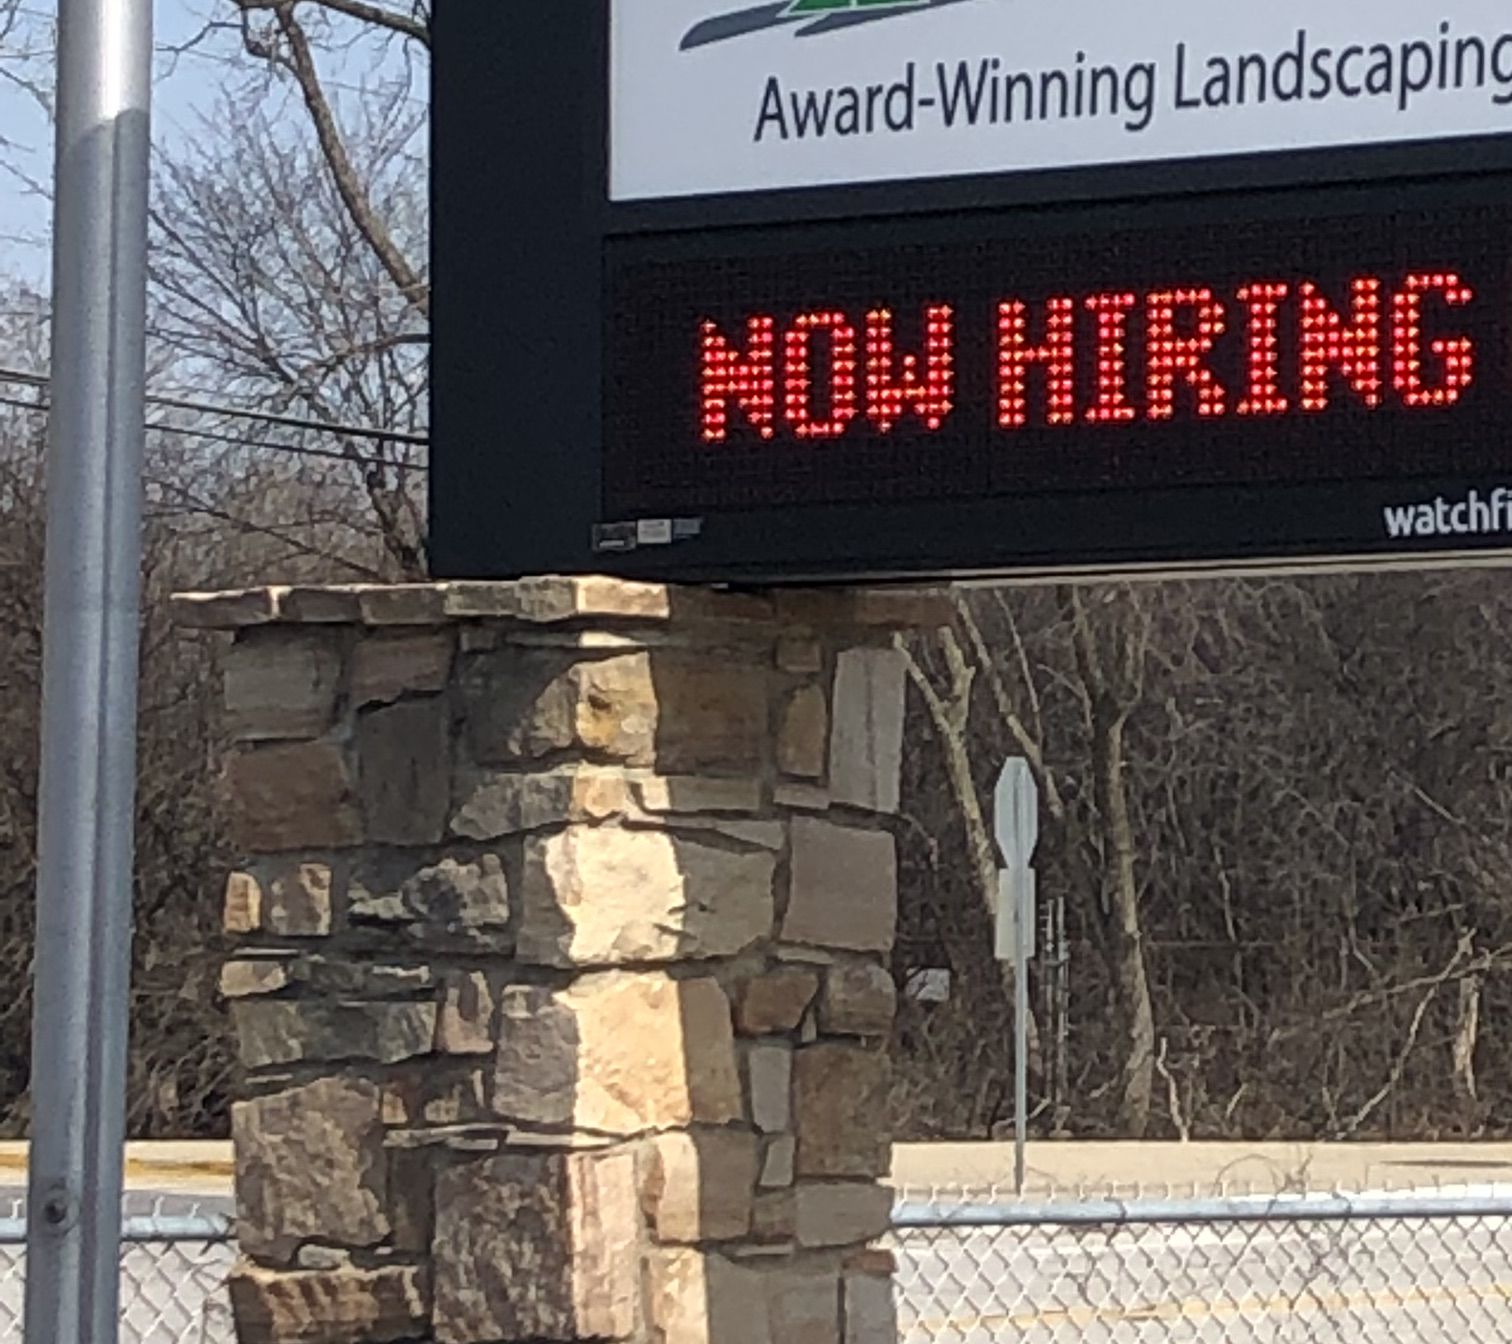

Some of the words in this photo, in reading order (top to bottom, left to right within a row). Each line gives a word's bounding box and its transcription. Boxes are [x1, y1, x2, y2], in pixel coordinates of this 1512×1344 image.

[752, 51, 1156, 142] Award-Winning
[701, 305, 953, 442] NOW
[998, 272, 1474, 427] HIRING
